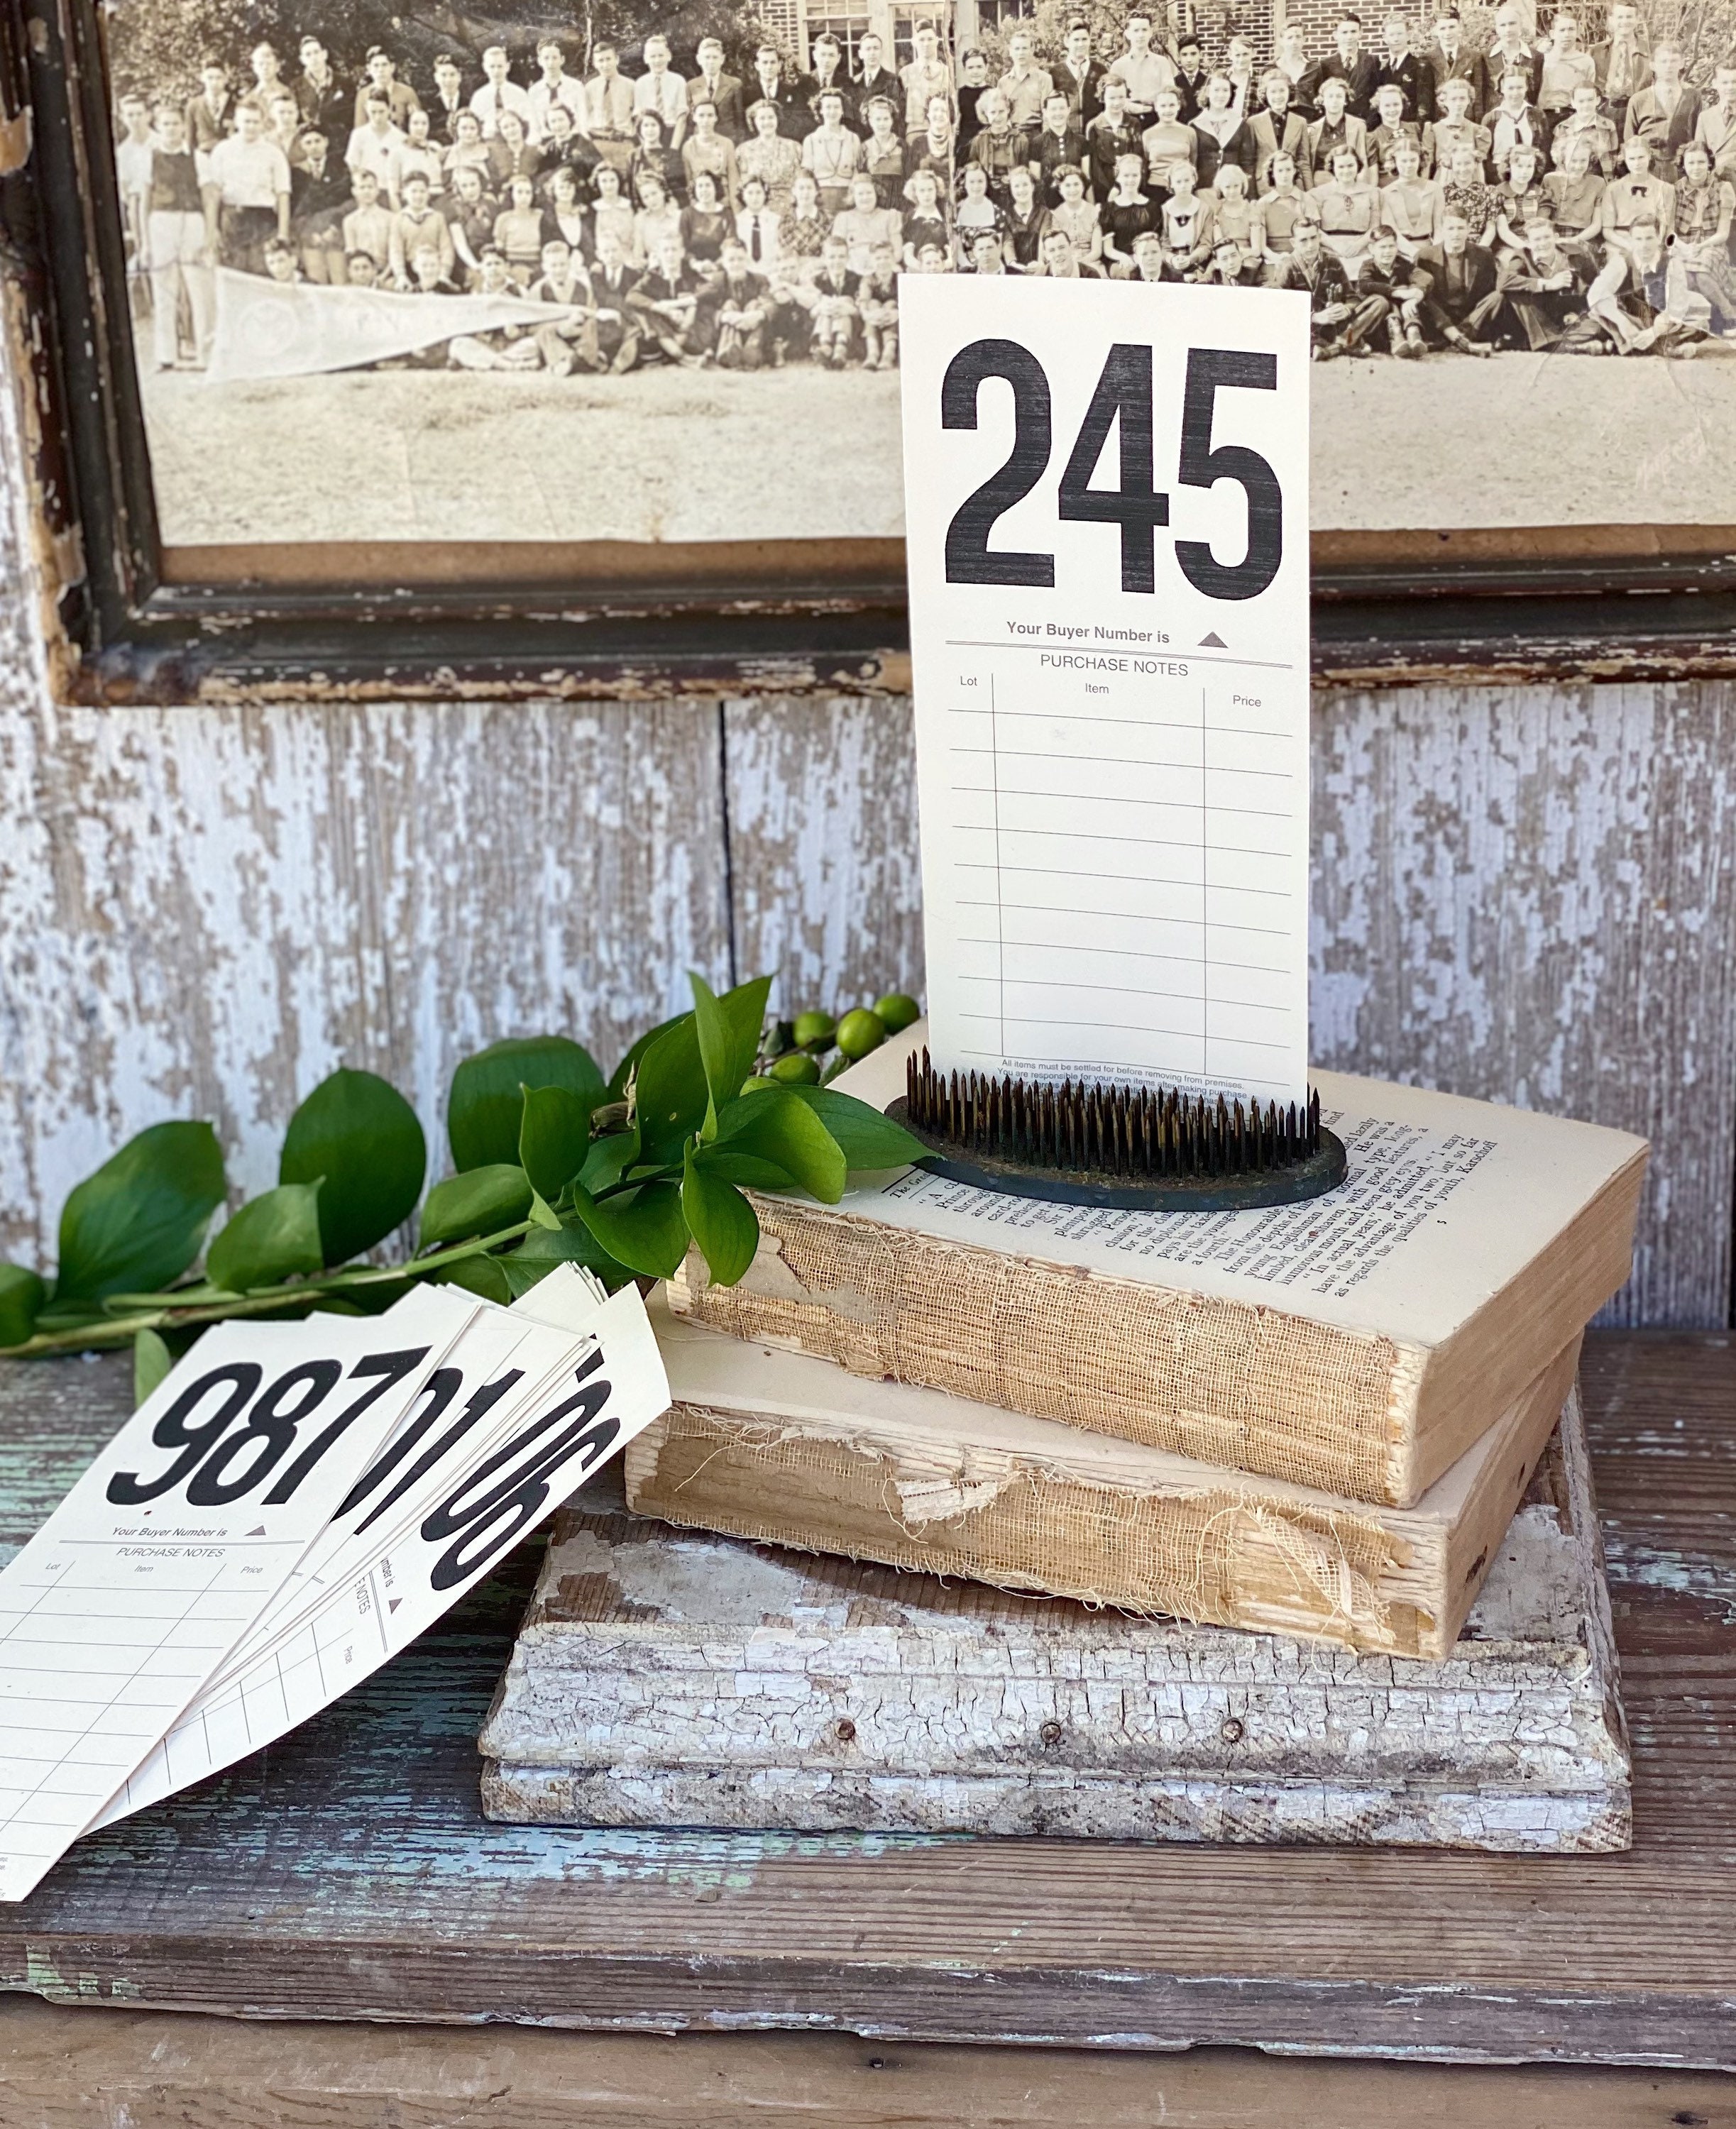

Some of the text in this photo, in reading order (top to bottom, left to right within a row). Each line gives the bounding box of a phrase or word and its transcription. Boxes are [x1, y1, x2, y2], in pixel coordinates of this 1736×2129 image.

[941, 339, 1282, 600] 245
[1006, 621, 1170, 644] Your Buyer Number is
[1040, 654, 1189, 677] PURCHASE NOTES
[960, 676, 1262, 708] Lot Item Price
[998, 1067, 1013, 1076] You
[1094, 1074, 1112, 1084] your
[1114, 1076, 1131, 1084] own
[1133, 1077, 1155, 1086] items
[1178, 1082, 1207, 1096] making
[1014, 1060, 1036, 1069] items
[1116, 1067, 1143, 1076] before
[1146, 1070, 1182, 1083] removing
[1184, 1074, 1202, 1084] from
[1369, 1126, 1389, 1140] was
[1353, 1140, 1374, 1152] He
[890, 1186, 910, 1199] The
[1175, 1249, 1192, 1262] are
[1187, 1237, 1207, 1249] the
[1322, 1111, 1345, 1125] find
[1214, 1117, 1380, 1260] The Honourable lazily
[1327, 1240, 1356, 1262] actual
[1377, 1201, 1396, 1211] he
[1392, 1165, 1434, 1199] admitted,
[1441, 1134, 1464, 1150] may
[934, 1189, 970, 1209] Prince
[952, 1188, 991, 1213] through
[971, 1194, 1006, 1217] around
[1244, 1124, 1412, 1278] young Englishman of normal type, long-
[1257, 1255, 1298, 1281] limbed,
[1345, 1187, 1369, 1204] with
[1366, 1167, 1389, 1186] good
[1382, 1135, 1423, 1165] features,
[1292, 1199, 1314, 1211] his
[1033, 1209, 1050, 1221] get
[1043, 1214, 1065, 1225] Sir
[1071, 1210, 1114, 1240] shrugged
[1288, 1210, 1302, 1219] of
[1312, 1138, 1479, 1293] have the advantage of you two, but so far
[1334, 1140, 1498, 1297] as regards the qualities of youth, Karschoff
[1119, 1240, 1139, 1251] for
[1136, 1226, 1156, 1238] the
[1157, 1241, 1181, 1260] pays
[1173, 1230, 1194, 1241] his
[1190, 1211, 1218, 1228] taxes
[1258, 1220, 1292, 1243] depths
[1275, 1250, 1323, 1285] humorous
[1319, 1227, 1350, 1250] mouth
[1344, 1211, 1365, 1226] and
[1356, 1194, 1383, 1211] keen
[1378, 1176, 1402, 1194] grey
[1138, 1244, 1155, 1255] no
[1245, 1243, 1265, 1254] the
[1223, 1255, 1252, 1273] from
[106, 1345, 434, 1507] 987
[112, 1527, 228, 1539] Your Buyer Number is
[116, 1548, 226, 1558] PURCHASE NOTES
[240, 1566, 263, 1574] Price
[385, 1575, 396, 1588] is
[356, 1584, 370, 1614] NOTES
[344, 1645, 353, 1664] Price
